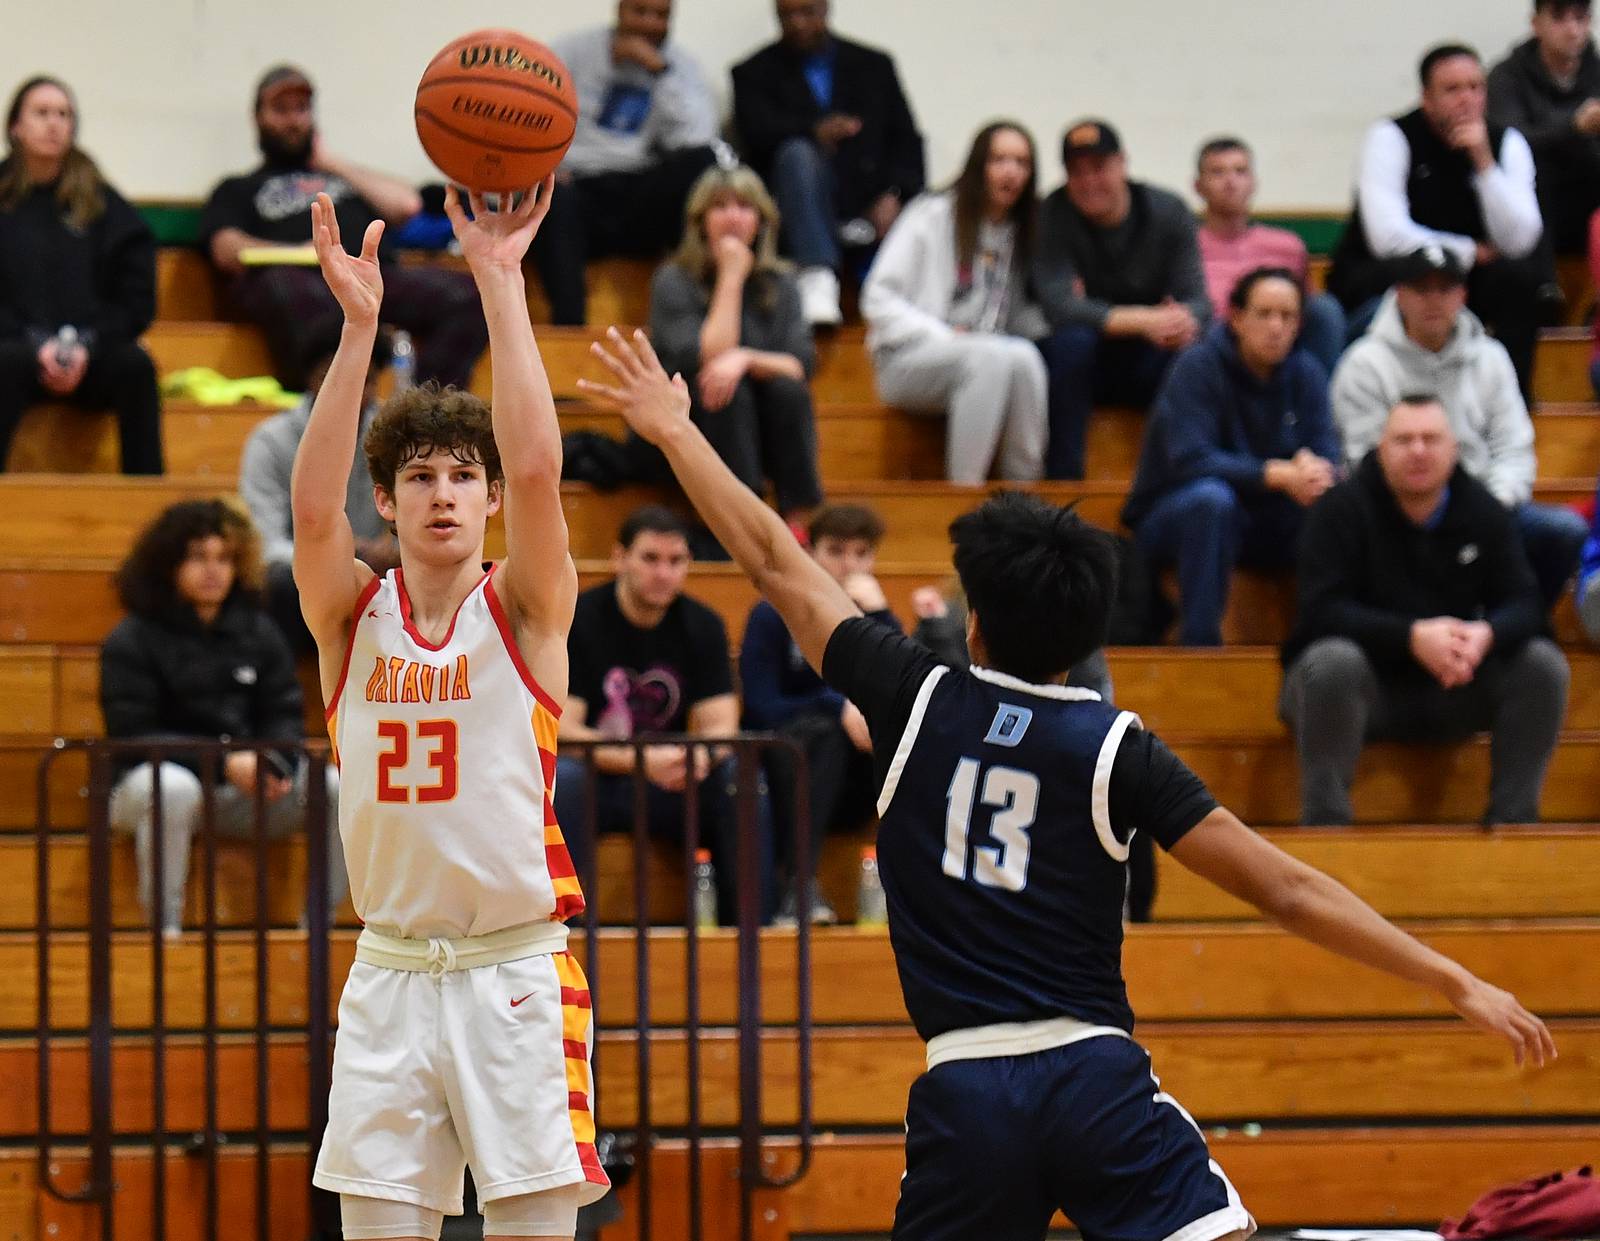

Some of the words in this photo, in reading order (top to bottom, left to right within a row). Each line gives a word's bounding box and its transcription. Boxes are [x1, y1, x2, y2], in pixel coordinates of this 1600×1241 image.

[459, 43, 562, 89] Wilson
[451, 95, 554, 133] EVOLUTION
[984, 702, 1033, 748] D
[377, 718, 459, 804] 23
[941, 755, 1041, 892] 13
